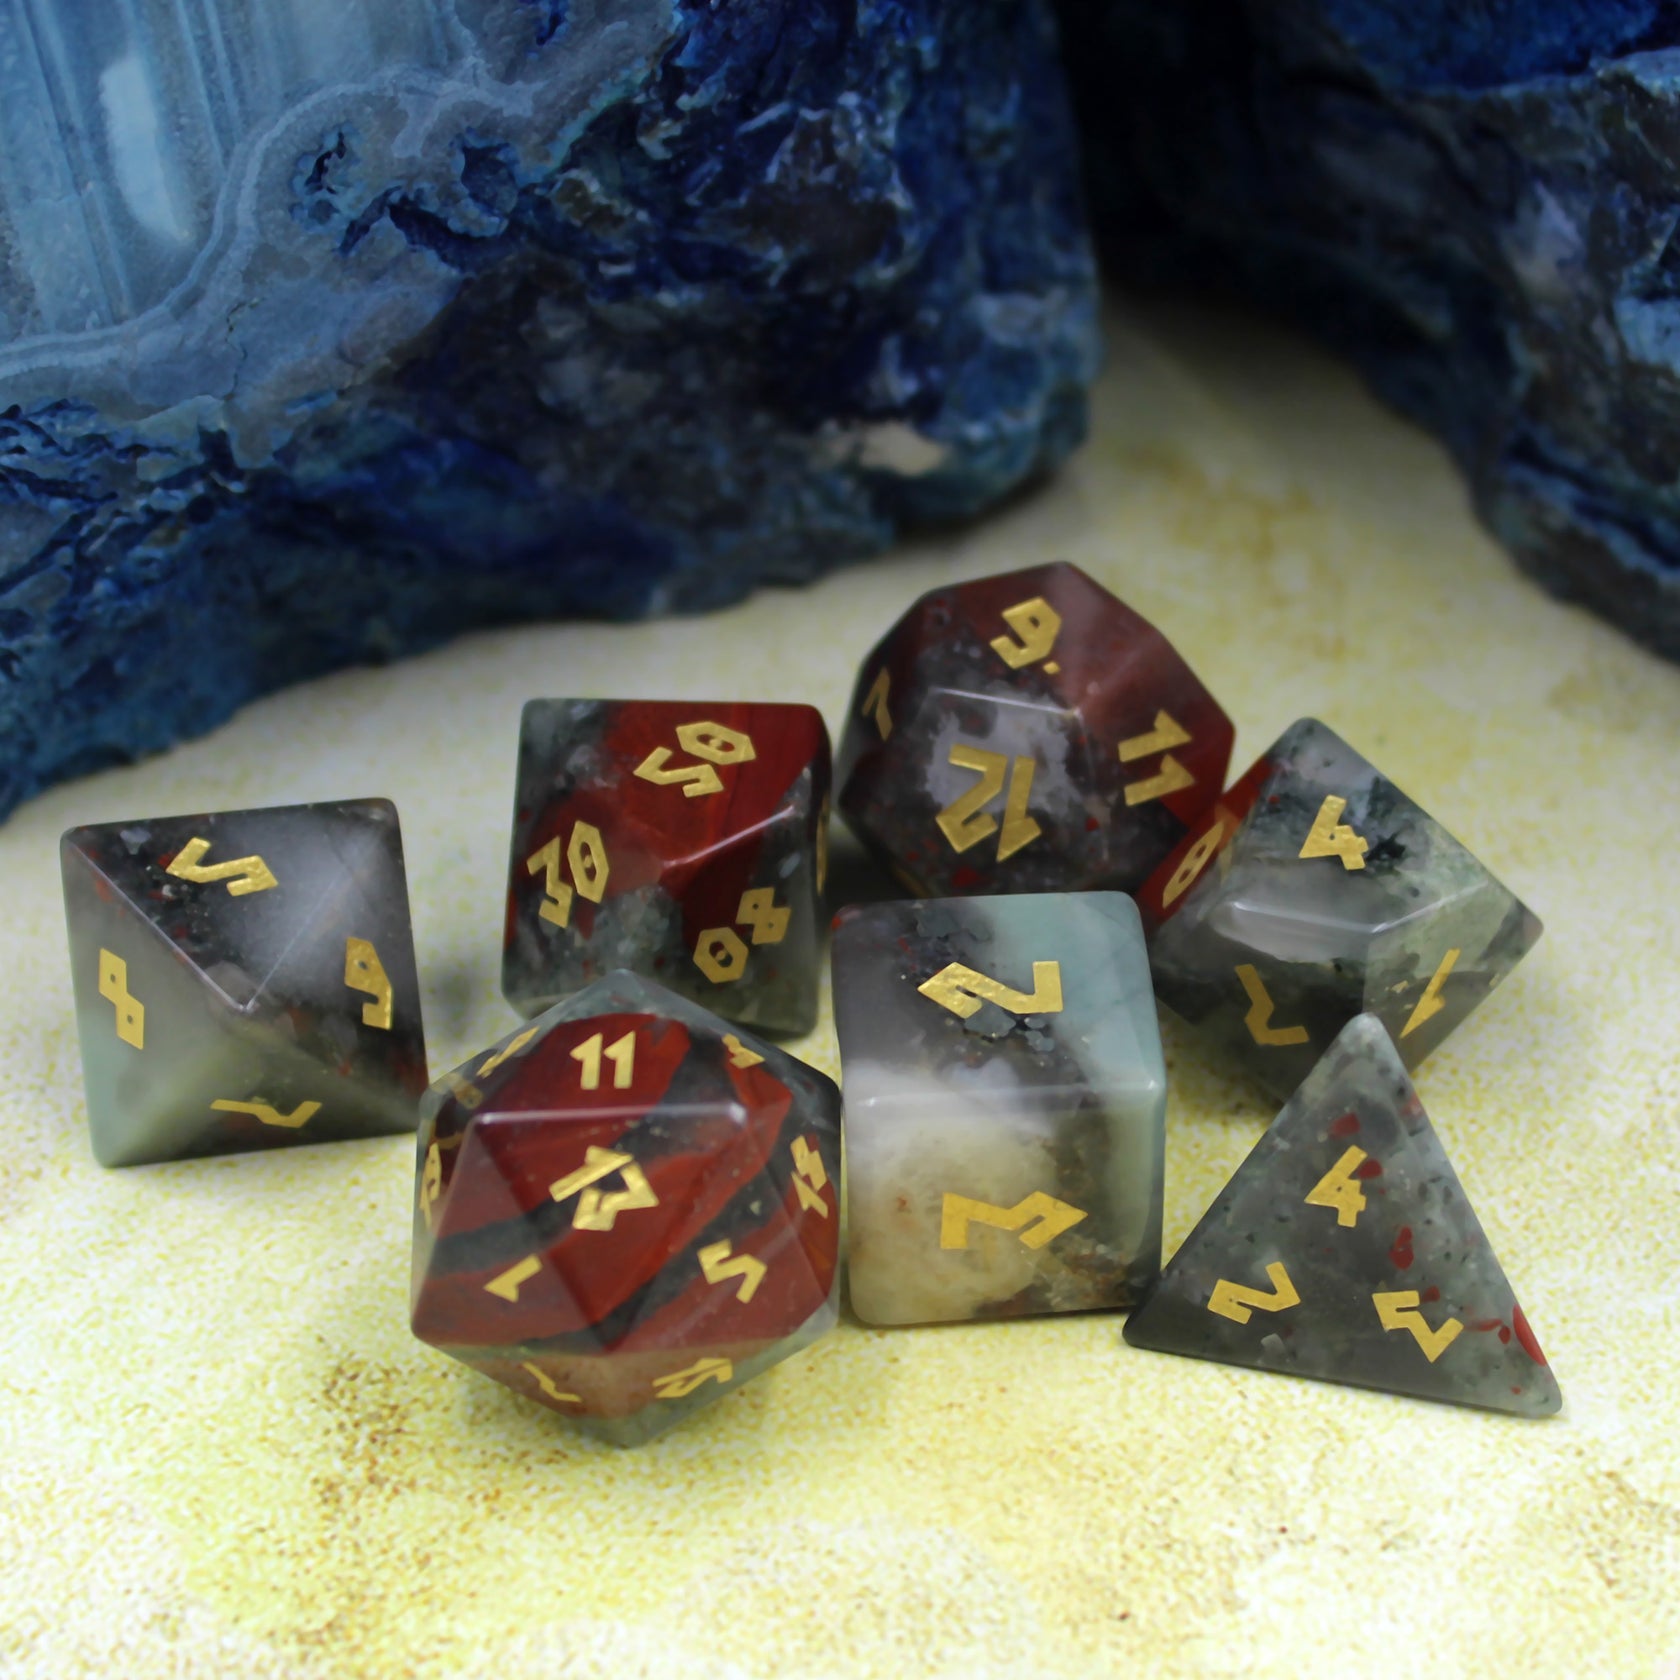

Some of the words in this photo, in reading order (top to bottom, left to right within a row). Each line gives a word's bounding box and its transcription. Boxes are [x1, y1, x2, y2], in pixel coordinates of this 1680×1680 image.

[935, 743, 1042, 863] 12
[1299, 794, 1369, 871] 4
[525, 819, 611, 929] 30
[692, 886, 792, 985] 80
[98, 947, 145, 1050] 8
[570, 1031, 636, 1090] 11
[1304, 1144, 1368, 1229] 4
